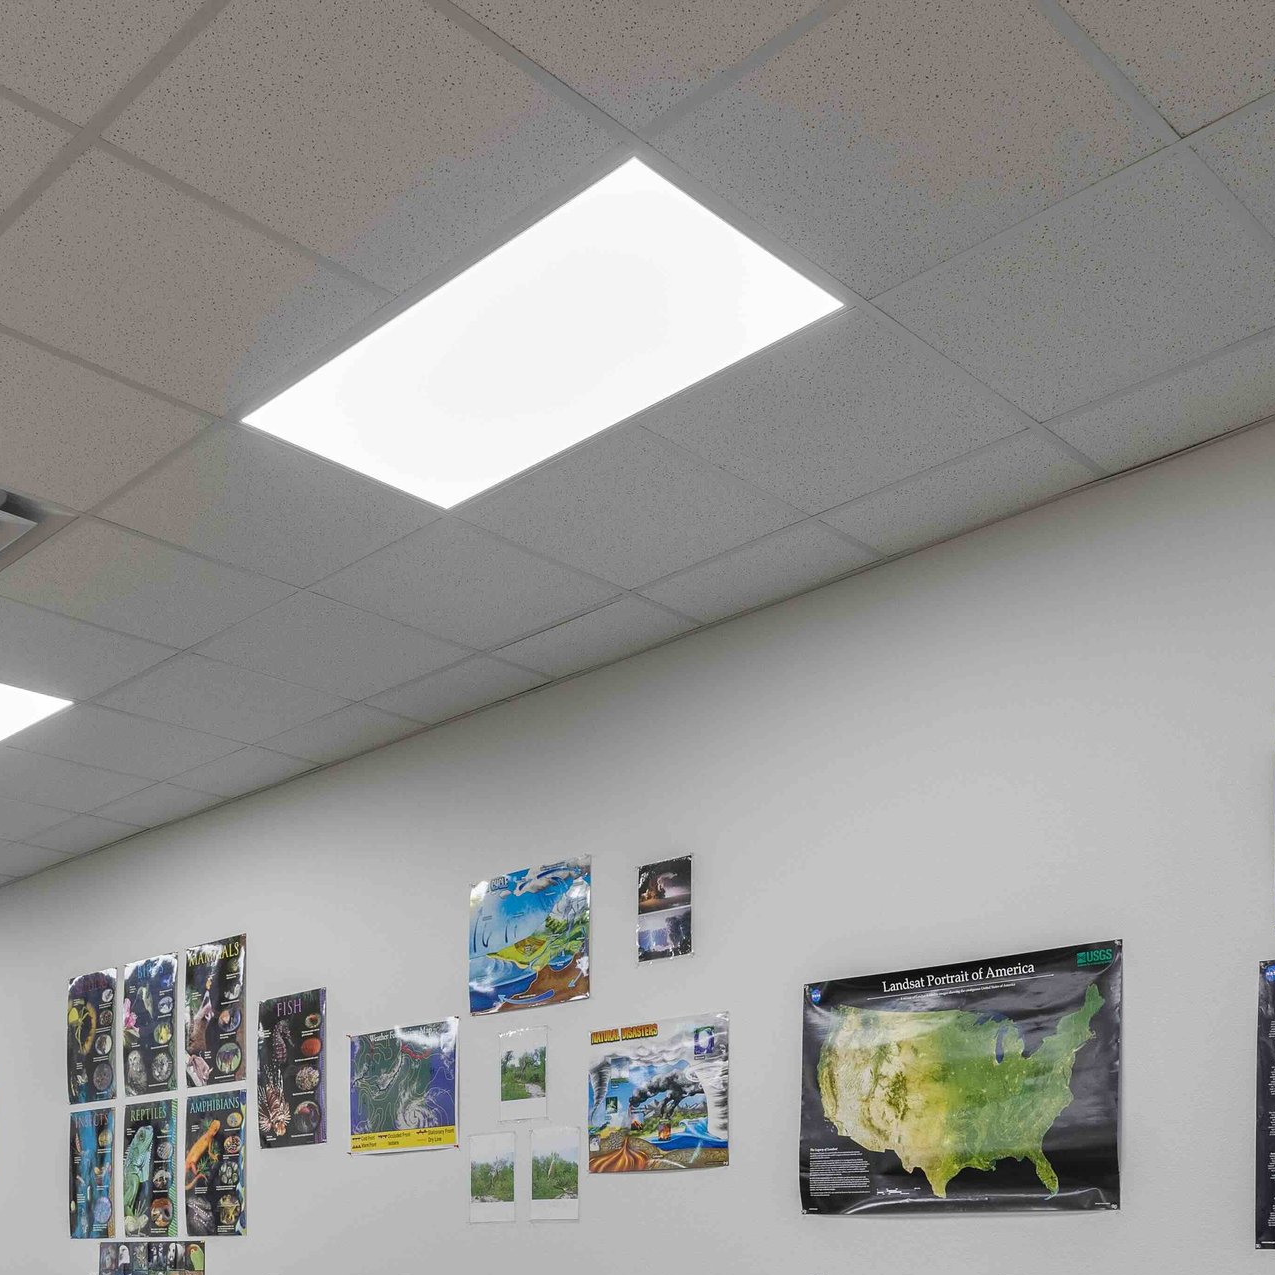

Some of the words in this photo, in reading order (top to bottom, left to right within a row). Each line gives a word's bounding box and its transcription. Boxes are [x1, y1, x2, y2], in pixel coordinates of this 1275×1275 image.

[1087, 950, 1112, 961] USGS
[882, 977, 925, 992] Landsat
[927, 970, 969, 987] Portrait
[972, 969, 983, 980] of
[986, 963, 1035, 979] America
[277, 999, 302, 1017] FISH
[591, 1029, 620, 1045] NATURAL
[621, 1024, 658, 1040] DISASTERS
[130, 1106, 167, 1121] REPTILES
[190, 1097, 240, 1113] AMPHIBIANS
